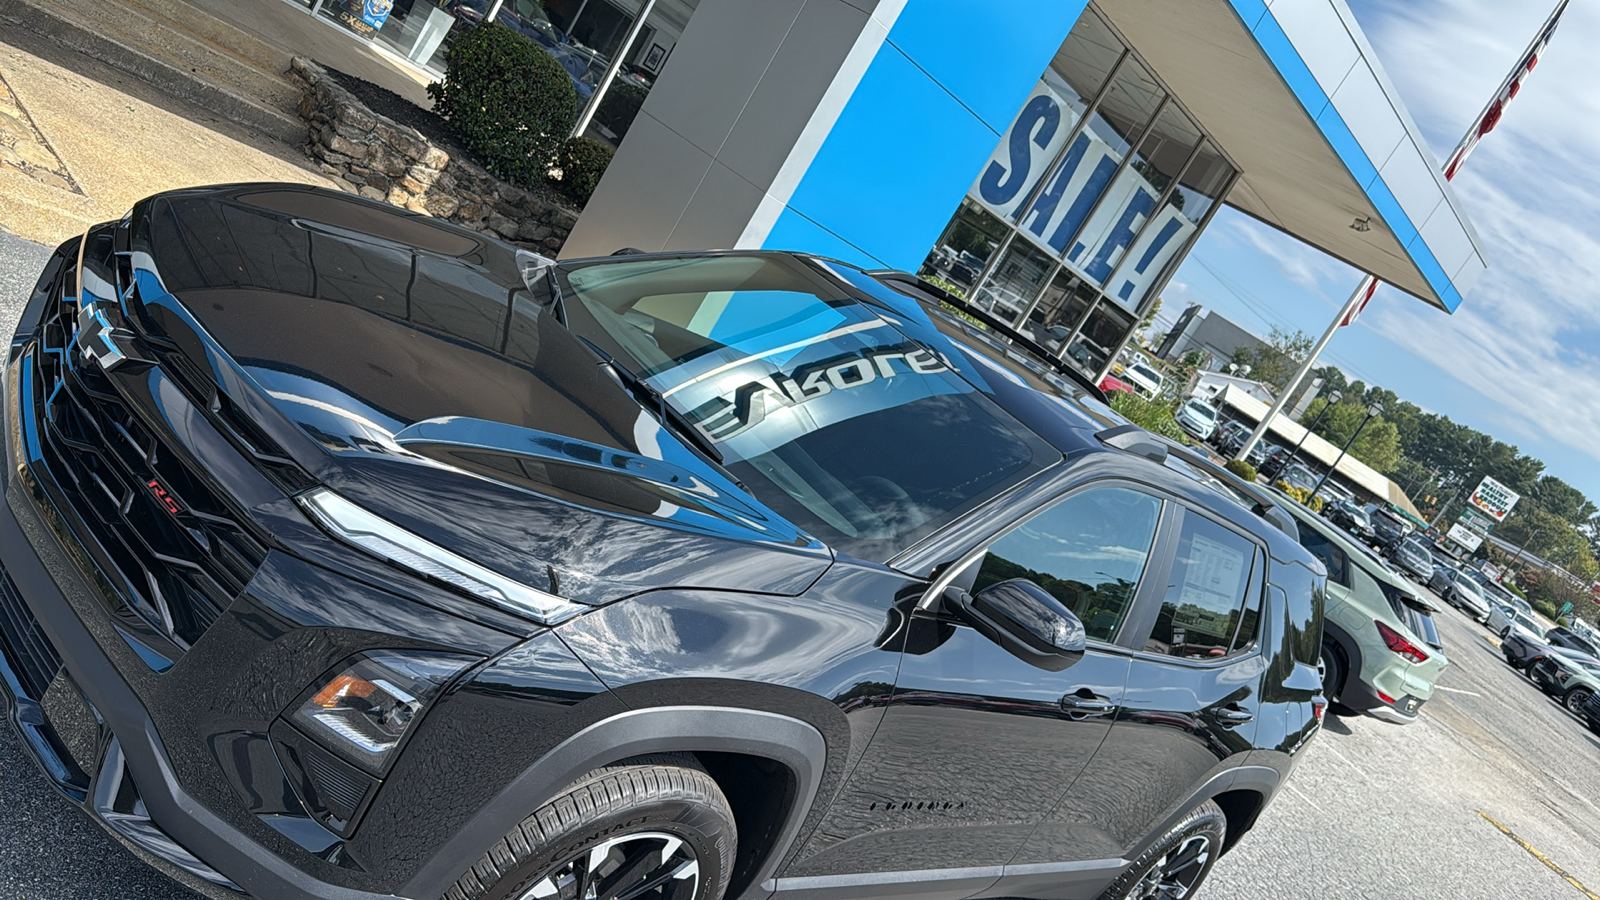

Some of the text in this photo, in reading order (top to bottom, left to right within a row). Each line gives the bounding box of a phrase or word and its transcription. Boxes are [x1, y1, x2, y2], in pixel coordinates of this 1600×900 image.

[340, 11, 357, 26] 5X
[979, 94, 1184, 302] SALE!
[148, 481, 182, 513] RS
[1480, 488, 1509, 507] HARVEST
[1481, 481, 1509, 500] HEALTHY
